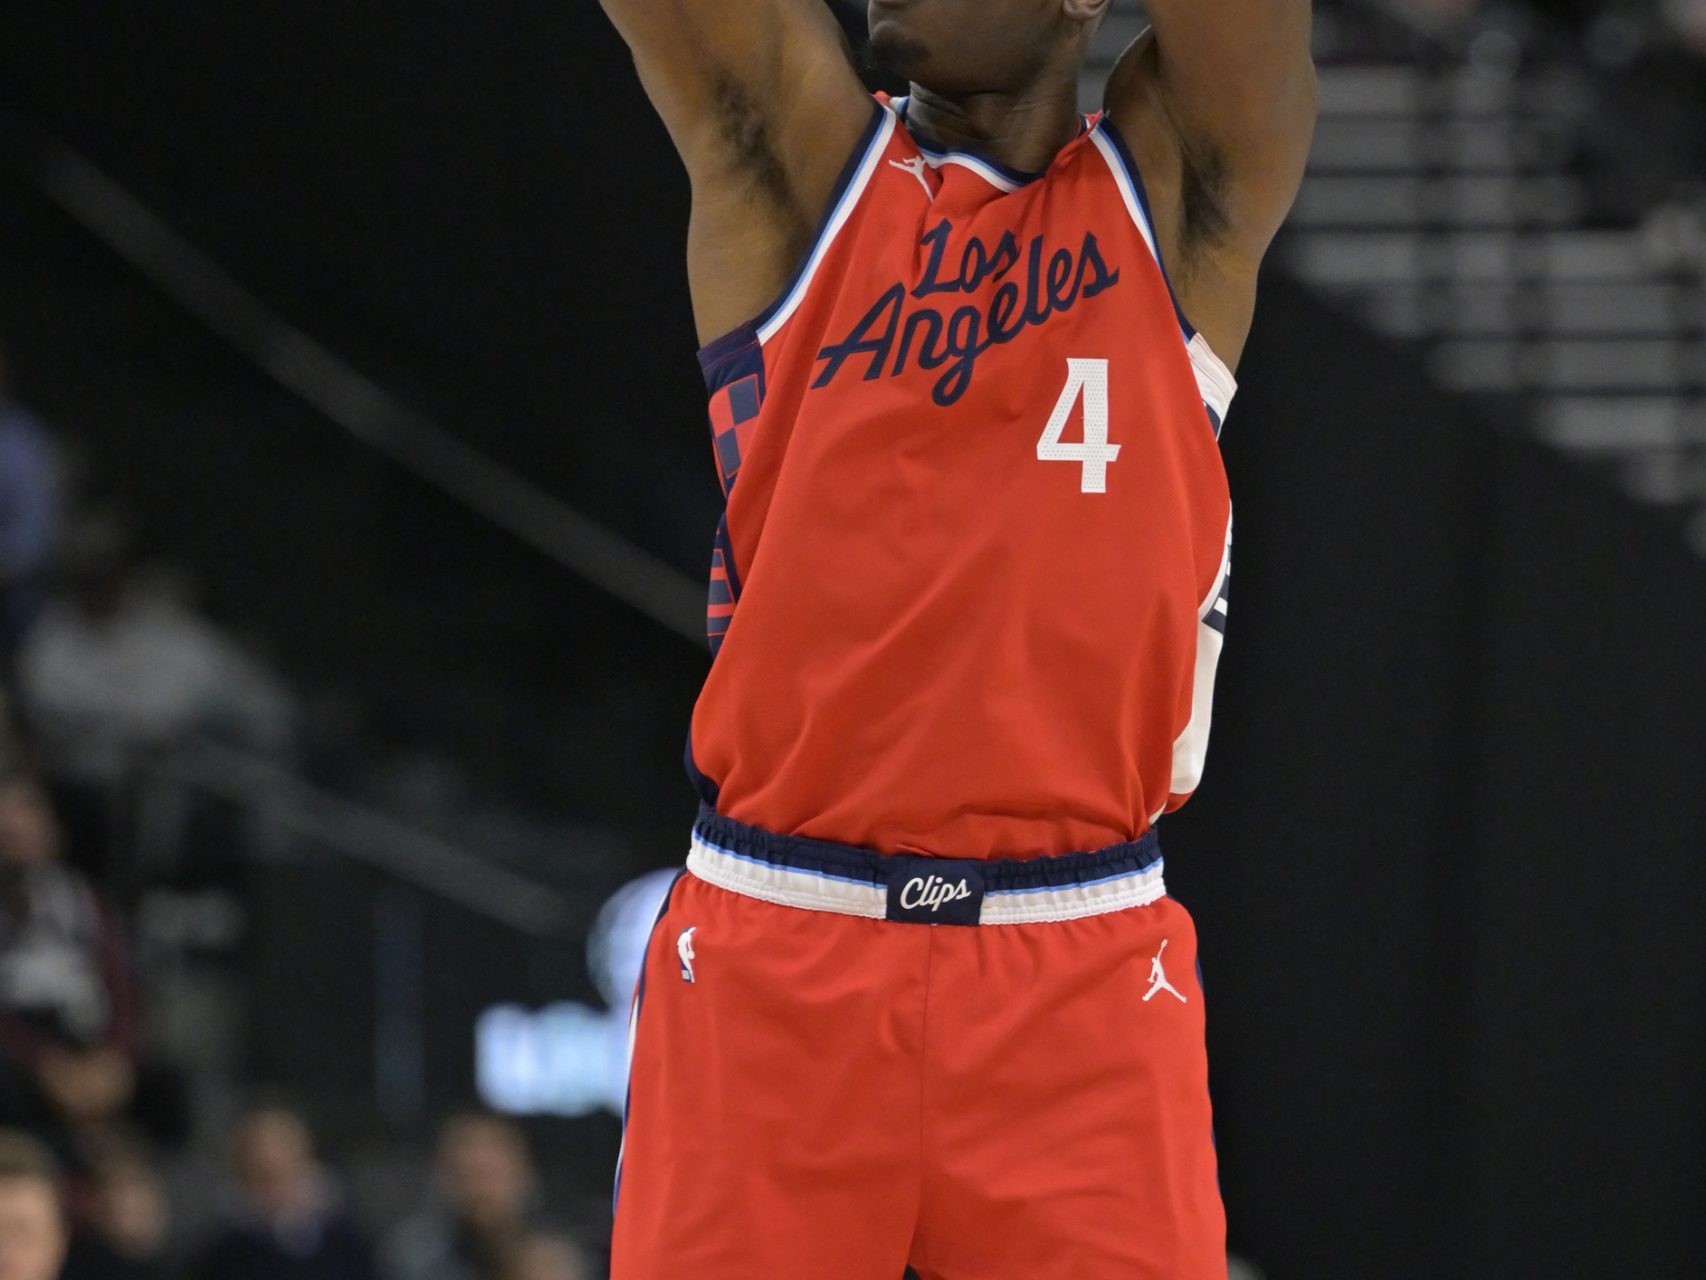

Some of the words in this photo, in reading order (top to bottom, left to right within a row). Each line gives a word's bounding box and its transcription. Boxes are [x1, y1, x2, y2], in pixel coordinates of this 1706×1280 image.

[911, 218, 1020, 299] Los
[811, 231, 1120, 407] Angeles
[1036, 357, 1122, 493] 4
[900, 874, 972, 912] Clips
